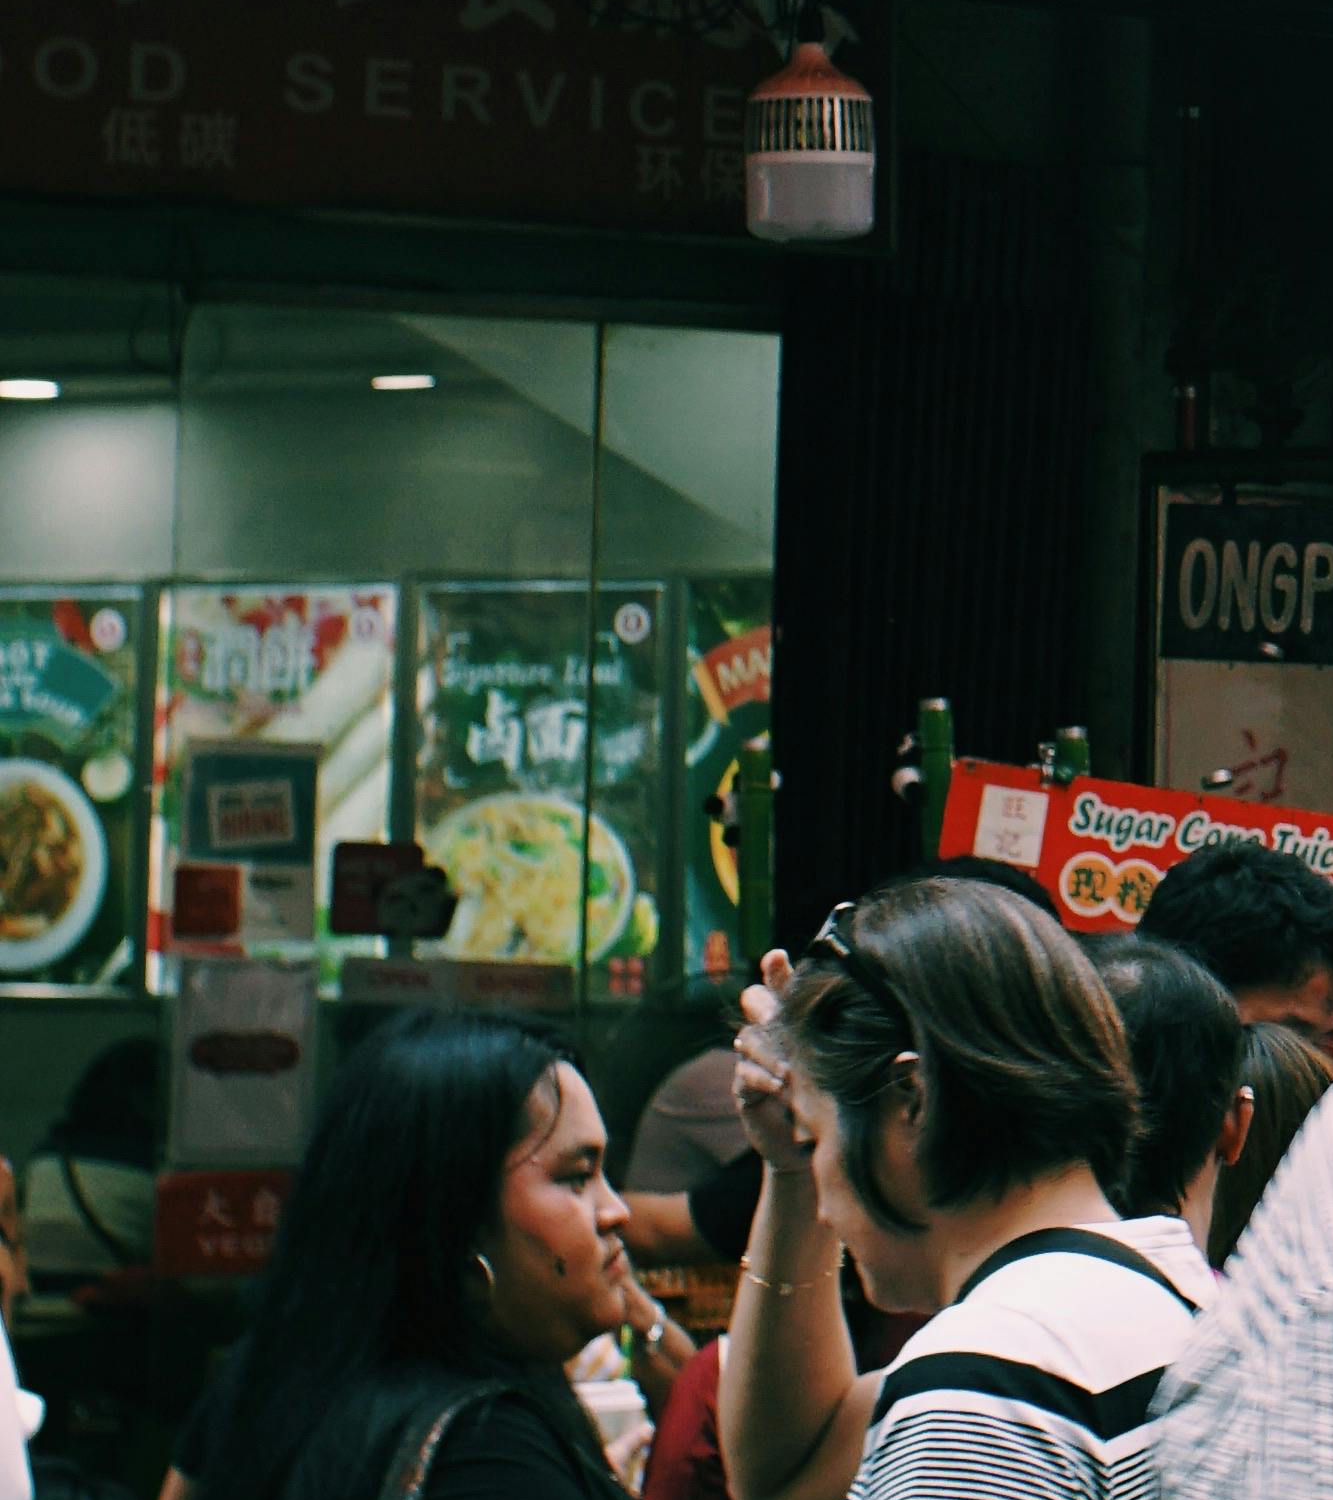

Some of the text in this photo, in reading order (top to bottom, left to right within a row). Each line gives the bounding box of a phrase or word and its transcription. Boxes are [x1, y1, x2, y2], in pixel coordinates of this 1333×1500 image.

[0, 35, 746, 143] OD SERVICE
[1071, 796, 1172, 850] Sugar
